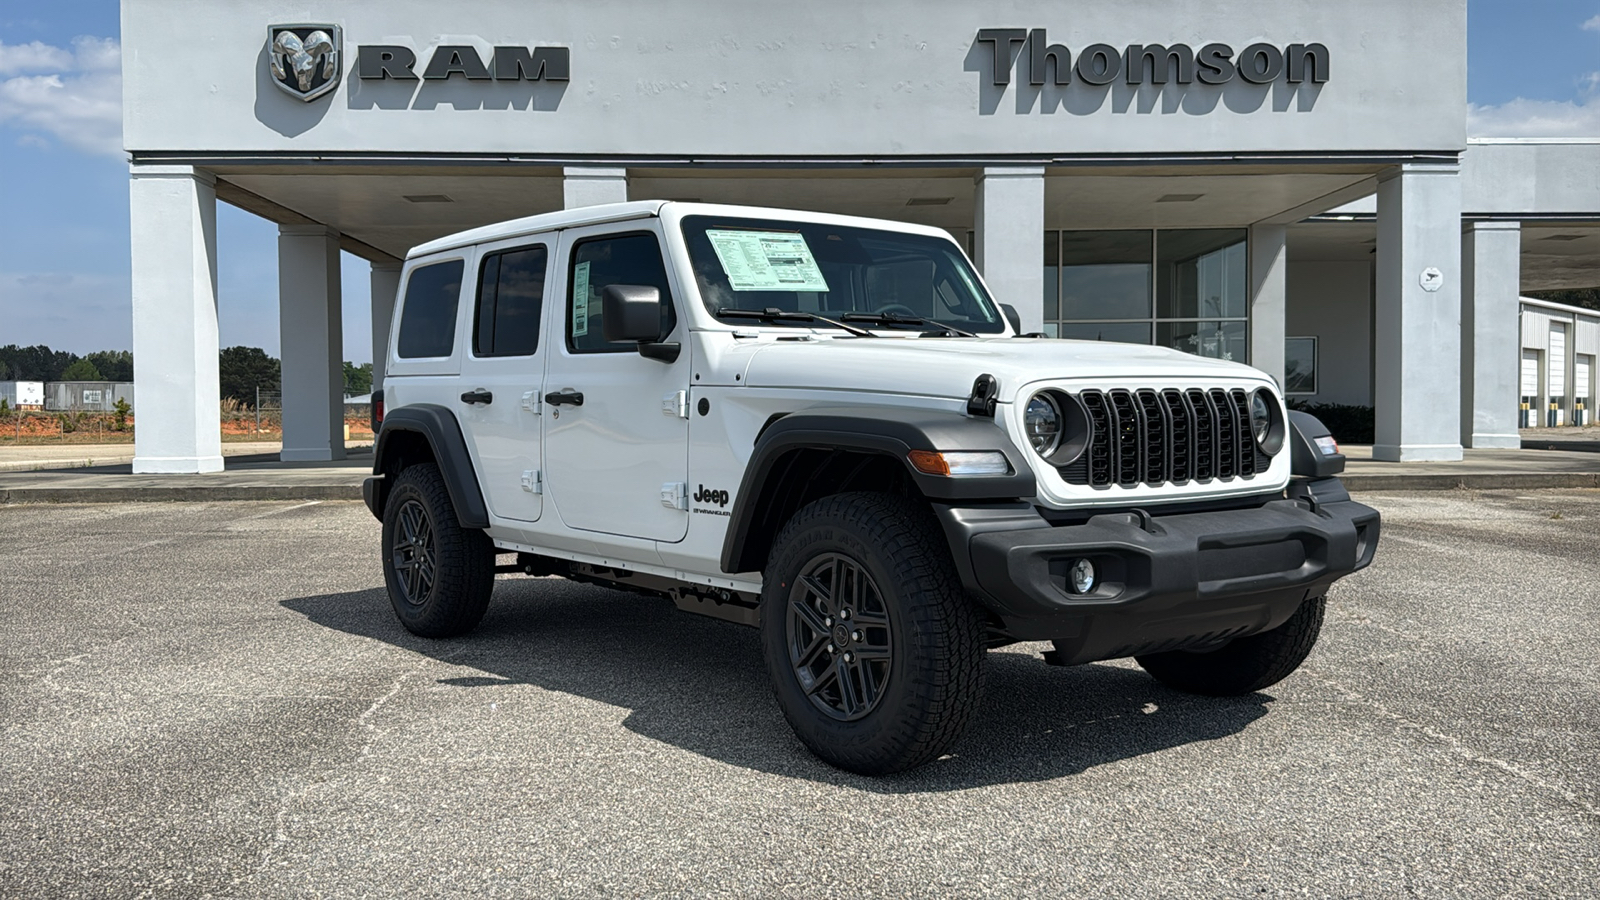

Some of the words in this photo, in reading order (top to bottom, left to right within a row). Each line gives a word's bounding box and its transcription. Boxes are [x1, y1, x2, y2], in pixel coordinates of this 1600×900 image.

[357, 45, 570, 82] RAM
[977, 28, 1330, 86] Thomson
[693, 483, 729, 508] Jeep
